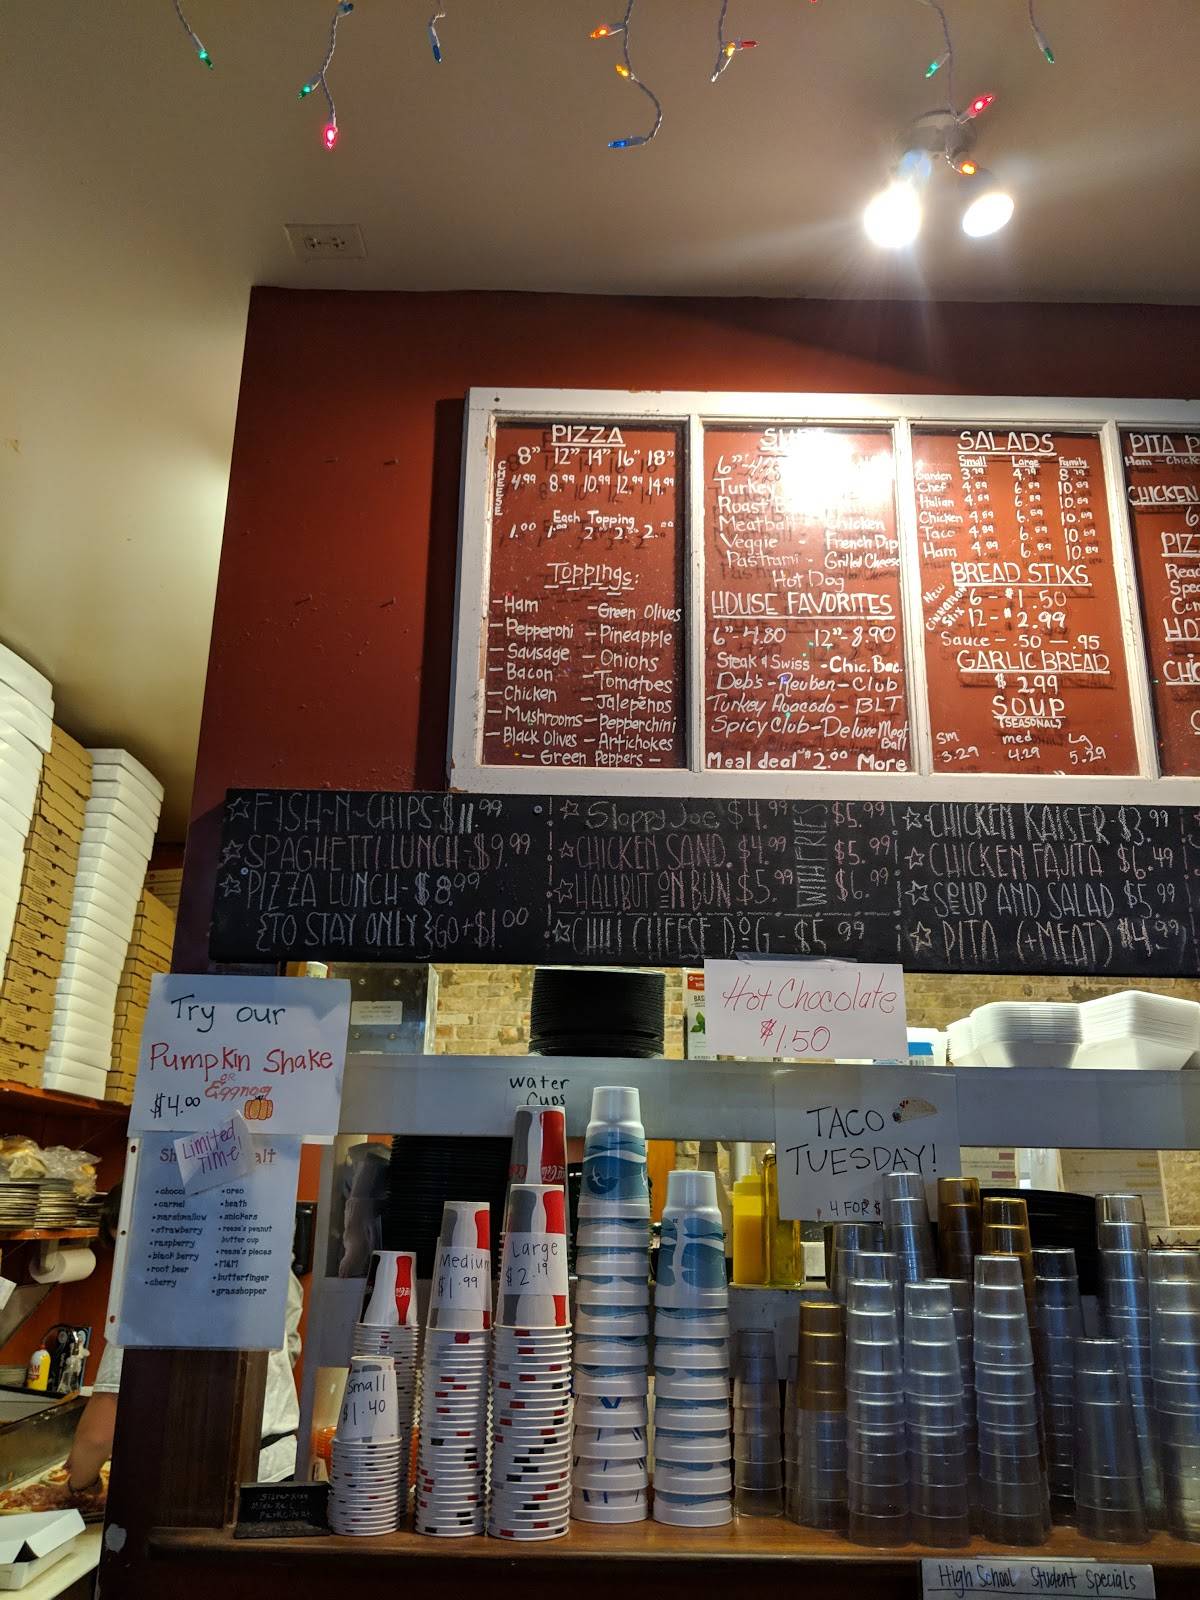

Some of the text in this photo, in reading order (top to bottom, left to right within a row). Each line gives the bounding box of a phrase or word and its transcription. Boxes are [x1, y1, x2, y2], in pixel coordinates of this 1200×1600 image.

[552, 424, 625, 444] PIZZA
[957, 431, 1055, 453] SALADS
[1129, 432, 1176, 455] PITA
[958, 456, 1088, 469] Small Large Family
[1124, 456, 1152, 467] Ham
[549, 474, 575, 492] 8.99
[583, 474, 610, 493] 10.99
[617, 475, 643, 495] 12.99
[648, 477, 675, 495] 14.99
[917, 482, 947, 493] Chef
[717, 496, 769, 514] Roast
[919, 493, 955, 508] Italian
[553, 510, 635, 528] Each Topping
[919, 511, 964, 525] Chicken
[720, 531, 899, 555] Veggie French Dip
[920, 525, 956, 540] Taco
[726, 550, 800, 569] Pastrami
[922, 542, 958, 559] Ham
[772, 569, 845, 593] Hot Dog
[951, 562, 1089, 585] BREAD STIXS
[504, 595, 538, 613] Ham
[597, 604, 681, 623] Green Olives
[711, 591, 893, 615] HOUSE FAVORITES
[506, 618, 574, 642] Pepperoni
[600, 624, 673, 649] Pineapple
[851, 625, 896, 647] 8.90
[941, 631, 991, 647] Sauce
[507, 643, 570, 666] Sausage
[600, 649, 659, 672] Onions
[717, 651, 757, 668] Steak
[770, 654, 810, 671] Swiss
[956, 650, 1110, 672] GARLIC BREAD
[506, 662, 553, 682] Bacon
[594, 670, 673, 695] Tomatoes
[504, 685, 557, 703] Chicken
[716, 672, 898, 697] Deb's Reuben Club
[505, 705, 583, 727] Mushrooms
[706, 693, 903, 718] Turkey BLT
[992, 695, 1065, 718] SOUP
[599, 714, 677, 736] Pepperchini
[711, 715, 767, 738] Spicy
[770, 715, 809, 734] Club
[820, 716, 877, 738] Deluxe
[503, 726, 578, 748] Black Olives
[598, 732, 673, 752] Artichokes
[881, 737, 907, 750] Ball
[1002, 731, 1032, 744] med
[540, 749, 643, 767] Green Peppers
[707, 751, 908, 772] Meal deal More
[1008, 747, 1041, 762] 4.29
[1069, 747, 1107, 765] 5.29
[585, 801, 666, 833] Sloppy
[671, 802, 720, 828] Joe
[929, 803, 1016, 840] CHICKEN
[1024, 803, 1111, 845] KAISER
[244, 834, 381, 872] SPAGHETTI
[576, 834, 660, 871] CHICKEN
[929, 842, 1027, 881] CHICKEN
[1033, 843, 1103, 881] FAJITA
[247, 869, 317, 911] PIZZA
[691, 869, 731, 911] BUN
[933, 881, 988, 918] SOUP
[998, 882, 1041, 919] AND
[1047, 882, 1115, 920] SALAD
[304, 911, 357, 946] STAY
[942, 919, 1000, 965] PITA
[722, 971, 898, 1014] Hot Chocolate
[171, 993, 286, 1033] Try our
[760, 1018, 831, 1054] $1.50
[150, 1042, 334, 1082] Pumpkin Shake
[509, 1075, 571, 1090] water
[150, 1092, 201, 1119] $4.00
[806, 1105, 885, 1139] TACO
[785, 1143, 937, 1175] TUESDAY!
[844, 1200, 870, 1216] FOR
[511, 1241, 559, 1262] Large
[505, 1262, 548, 1287] $2.19
[347, 1374, 386, 1395] Small
[939, 1564, 1137, 1598] High School Student Specials
